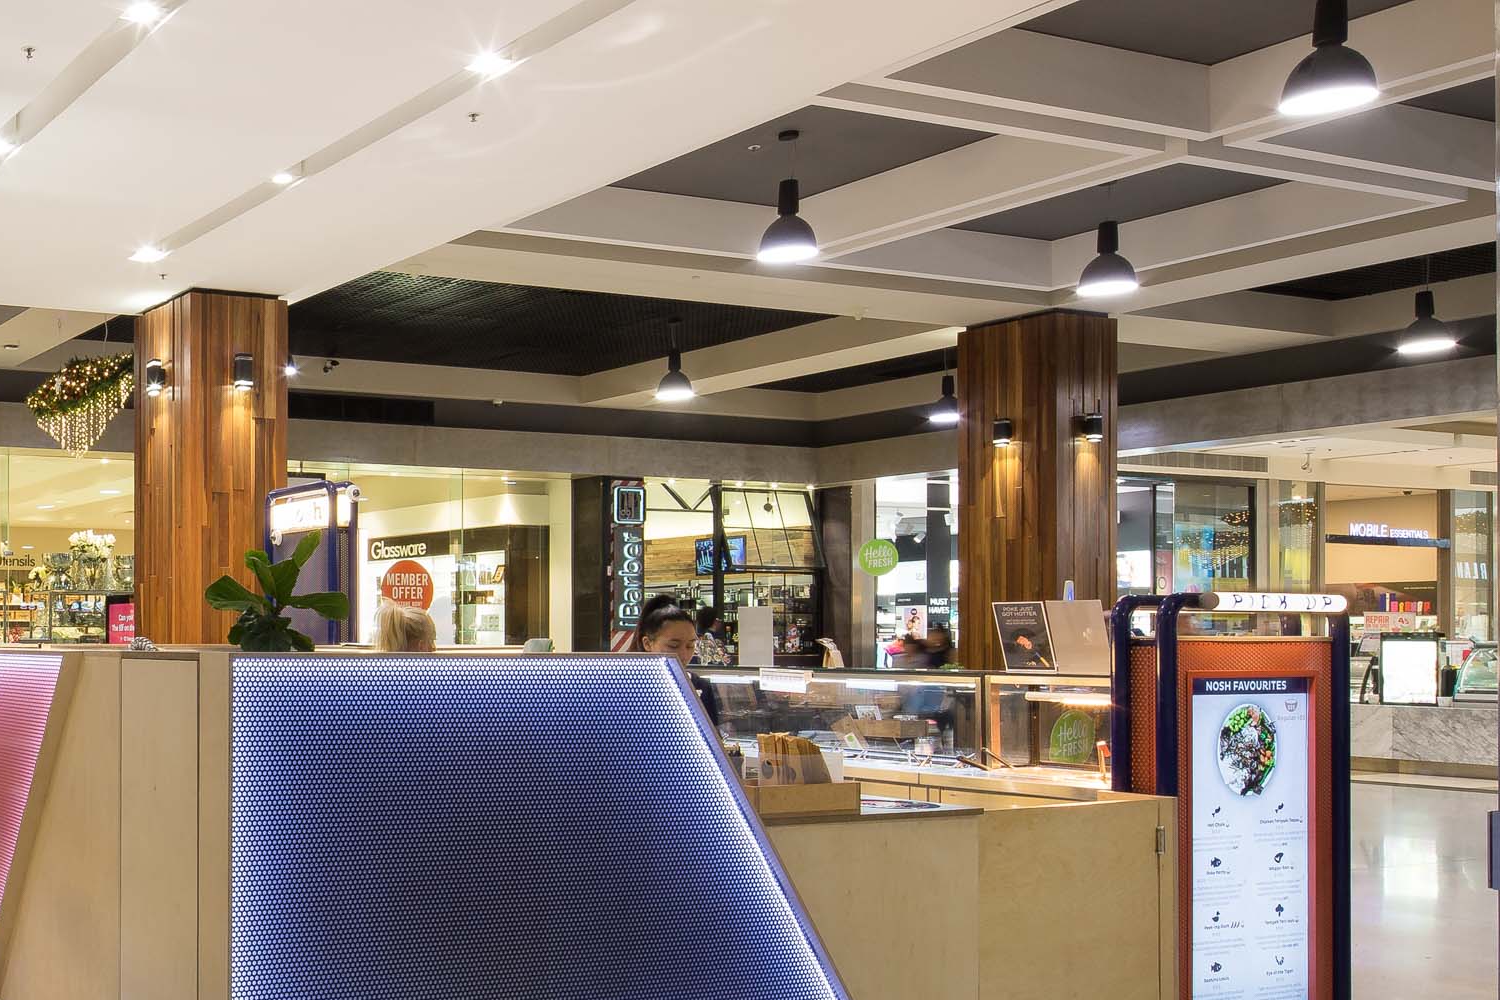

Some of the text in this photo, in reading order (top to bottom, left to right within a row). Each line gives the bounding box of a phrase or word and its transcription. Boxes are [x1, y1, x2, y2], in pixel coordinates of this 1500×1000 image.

[1348, 522, 1429, 539] MOBILE ESSENTIALS
[370, 540, 427, 561] Glassware
[864, 545, 893, 562] Hello
[868, 558, 893, 569] FRESH
[386, 572, 429, 587] MEMBER
[391, 586, 424, 600] OFFER
[929, 597, 949, 606] MUST
[1232, 593, 1333, 611] PICK UP
[928, 606, 950, 615] HAVES
[1365, 615, 1390, 625] REPAIR
[1205, 679, 1287, 692] NOSH FAVOURITES
[1058, 719, 1089, 747] Hello
[1062, 738, 1089, 757] FRESH
